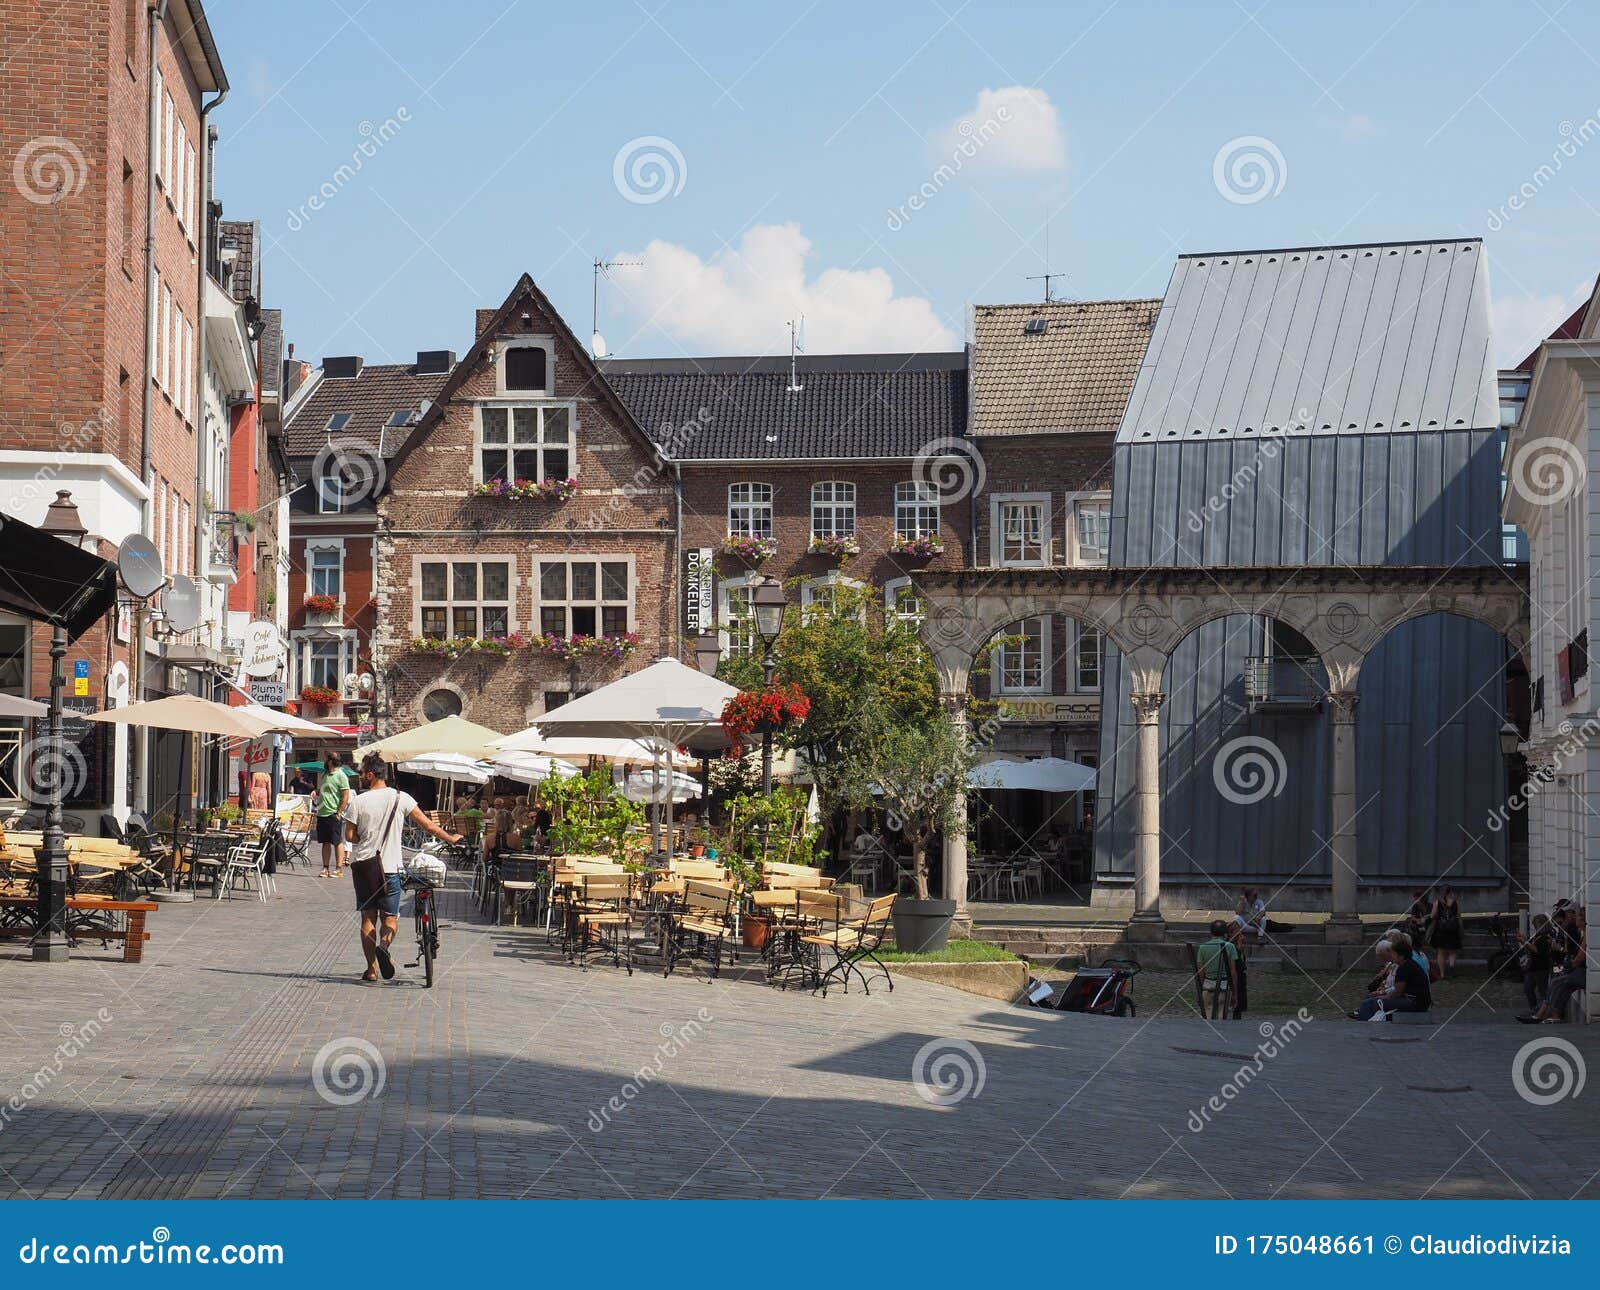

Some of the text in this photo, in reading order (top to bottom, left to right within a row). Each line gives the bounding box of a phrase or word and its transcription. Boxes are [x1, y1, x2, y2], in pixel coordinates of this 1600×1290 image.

[687, 552, 699, 630] DOMKELLER
[251, 684, 284, 694] Plum's
[252, 694, 283, 703] Kaffee
